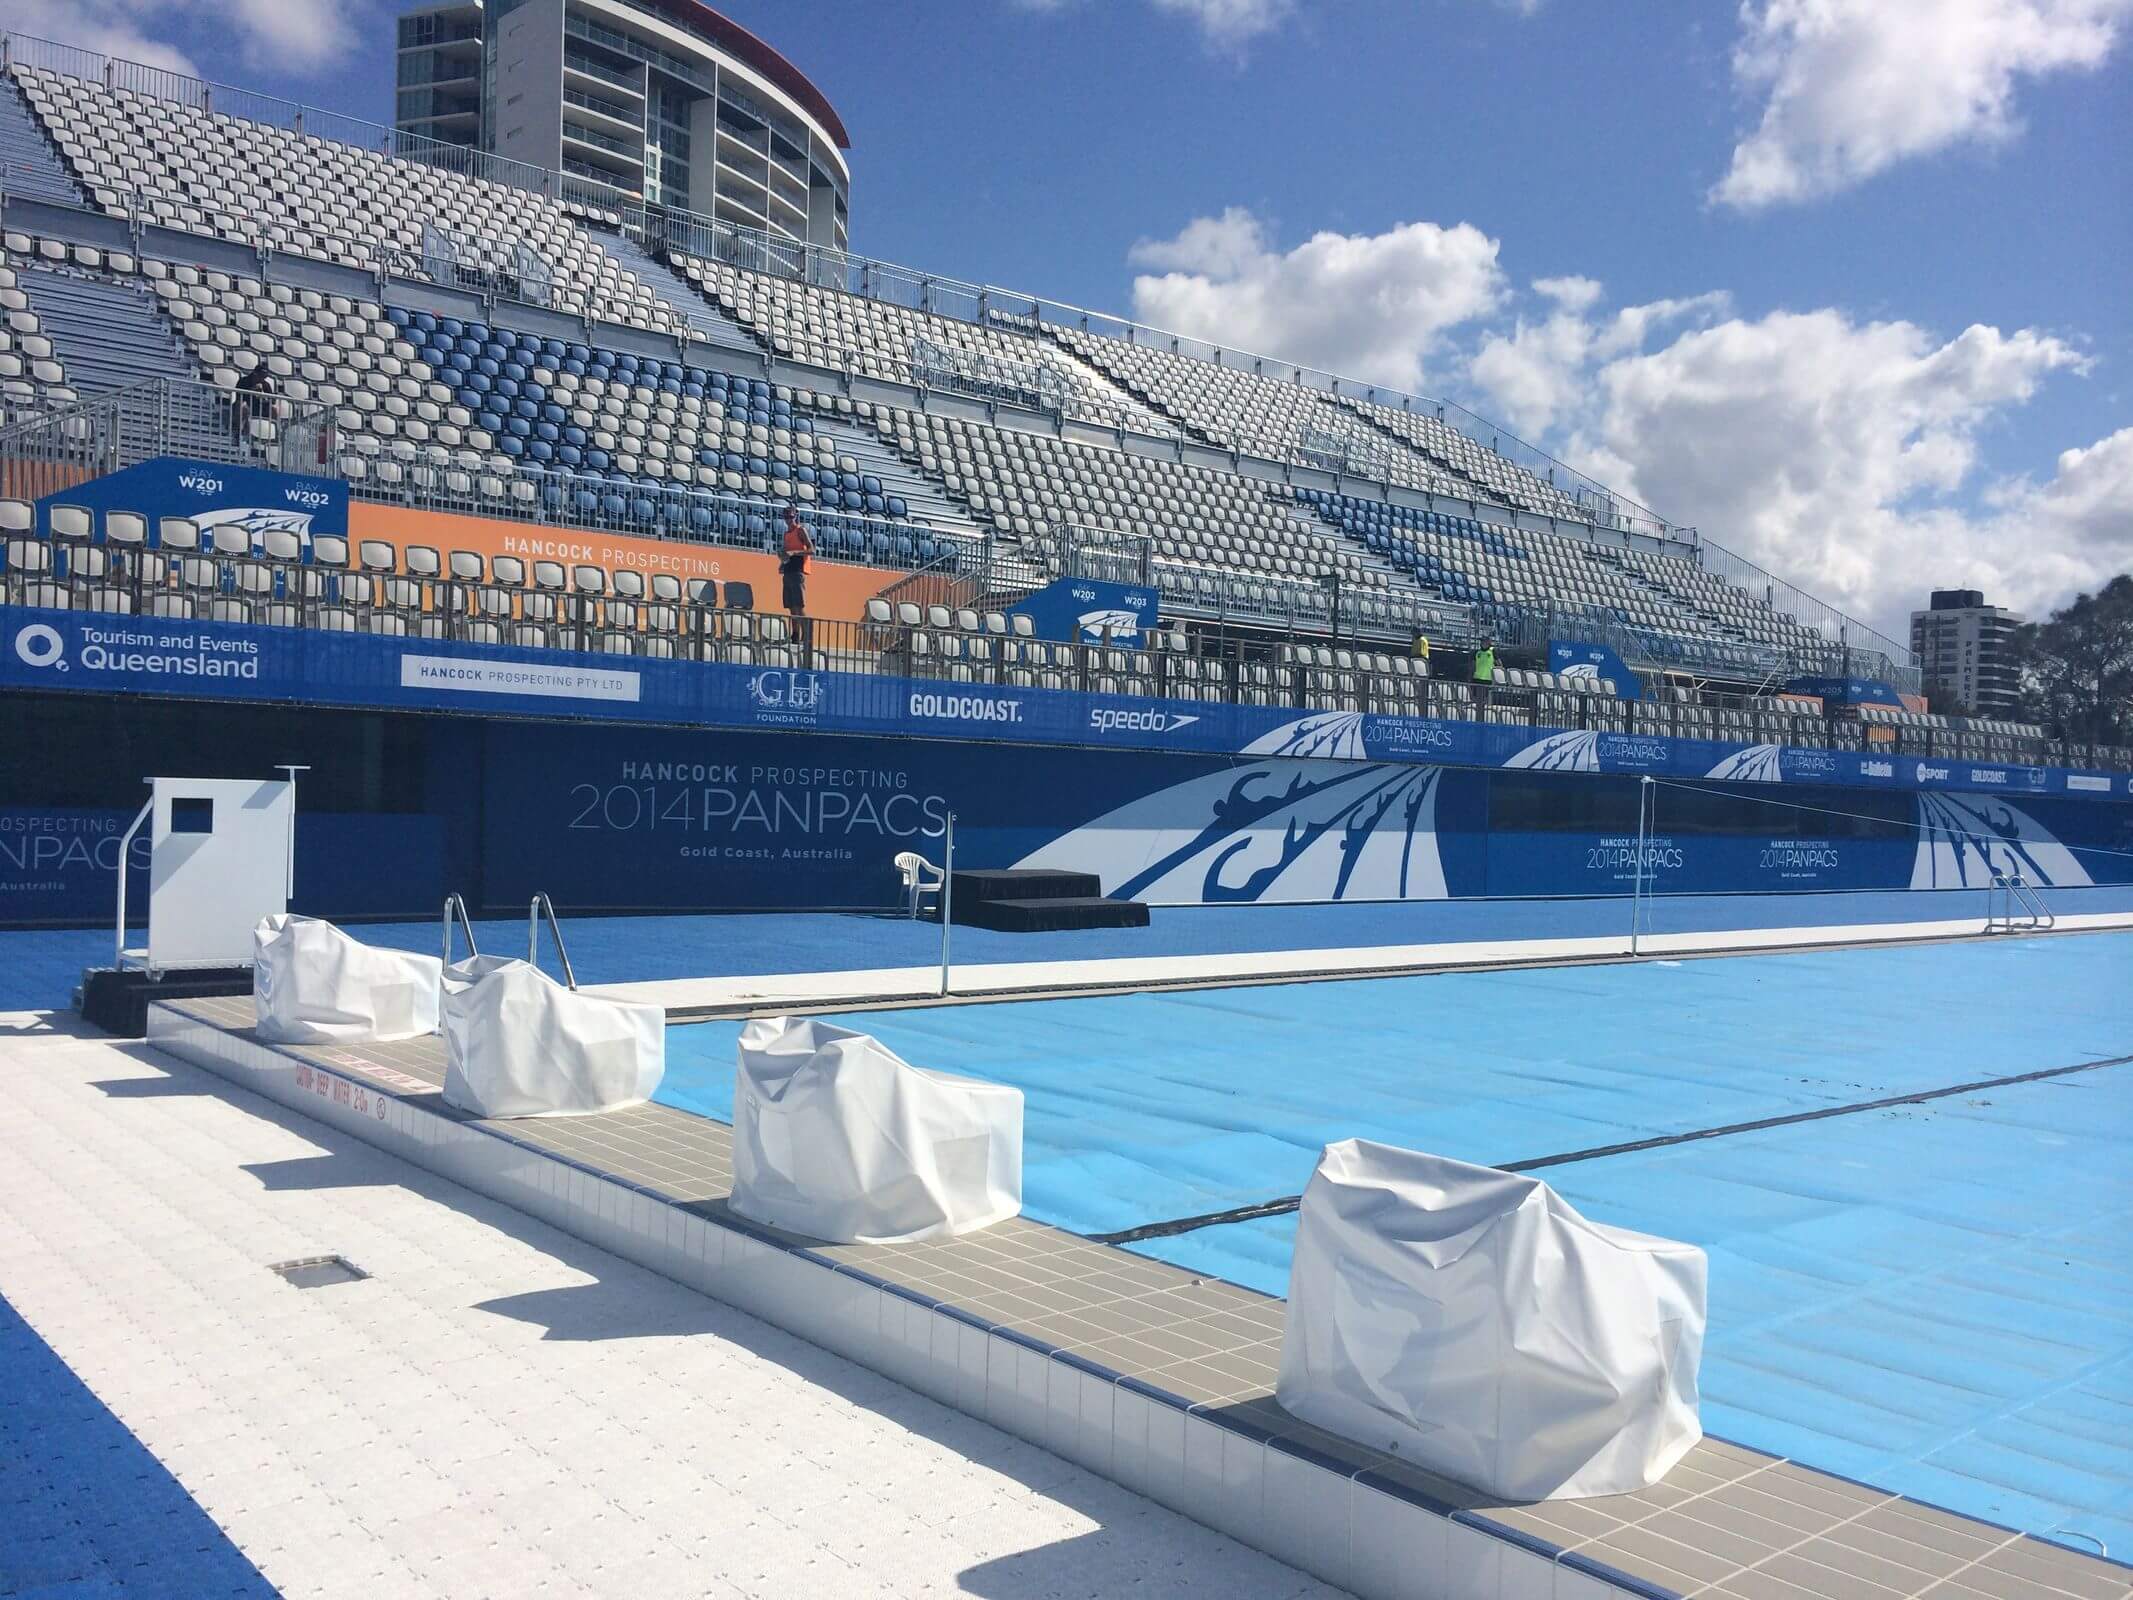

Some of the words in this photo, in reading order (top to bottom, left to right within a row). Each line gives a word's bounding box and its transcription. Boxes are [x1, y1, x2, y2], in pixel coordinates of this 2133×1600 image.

[179, 475, 223, 492] W201
[285, 489, 329, 505] W202
[504, 536, 592, 560] HANCOCK
[603, 548, 720, 575] PROSPECTING
[1072, 589, 1095, 600] W202
[1124, 596, 1147, 607] W203
[81, 627, 153, 646] Tourism
[160, 635, 193, 649] and
[200, 636, 258, 654] Events
[81, 645, 258, 678] Queensland
[421, 666, 482, 681] HANCOCK
[488, 671, 573, 687] PROSPECTING
[577, 677, 598, 689] PTY
[602, 679, 623, 690] LTD
[756, 713, 817, 725] FOUNDATION
[1090, 708, 1166, 733] speedo
[622, 761, 739, 783] HANCOCK
[751, 766, 908, 789] PROSPECTING
[0, 818, 117, 832] OSPECTING
[1600, 839, 1629, 847] HANCOCK
[1632, 839, 1671, 847] PRSPECTING
[680, 846, 718, 858] Gold
[724, 846, 775, 860] Coast,
[782, 847, 853, 860] Australia
[0, 881, 65, 891] Australia
